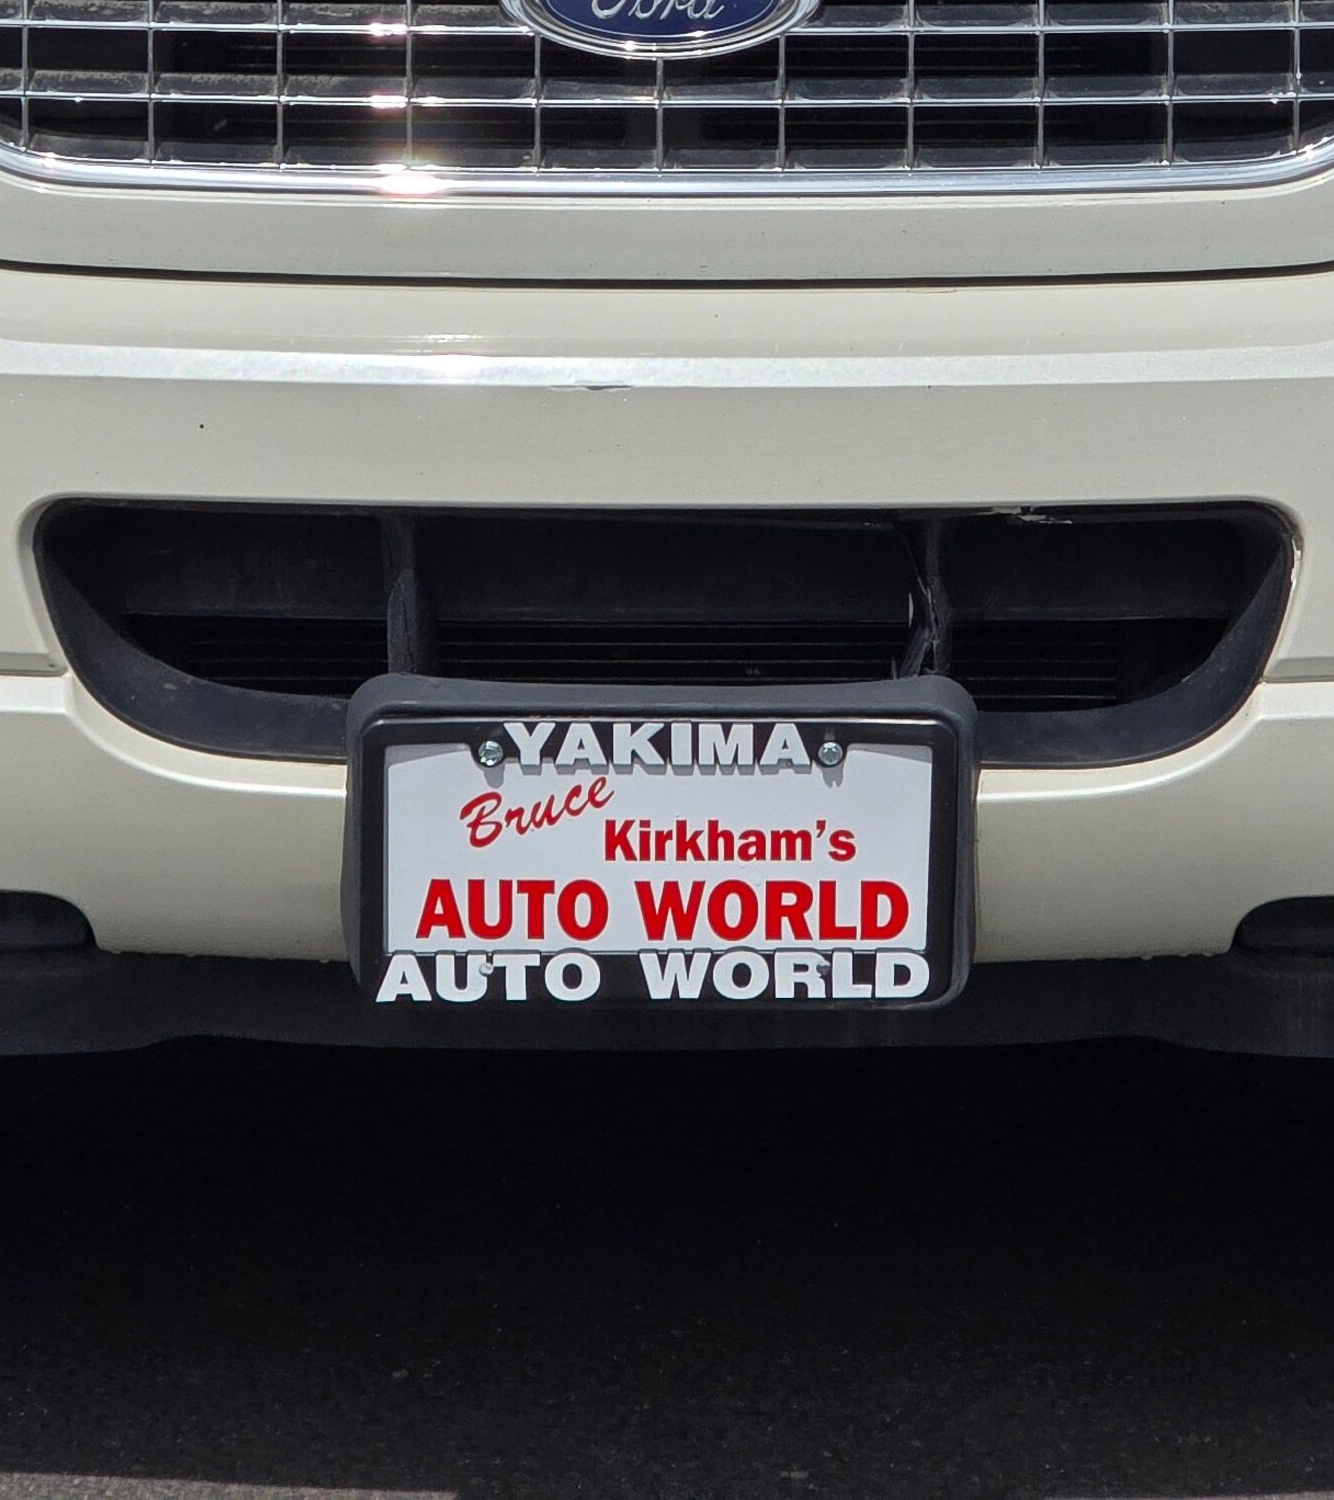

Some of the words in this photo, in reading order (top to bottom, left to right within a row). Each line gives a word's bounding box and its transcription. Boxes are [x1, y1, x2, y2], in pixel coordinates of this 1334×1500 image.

[503, 721, 811, 769] YAKIMA
[459, 775, 615, 848] Bruce
[604, 817, 857, 862] Kirkham's
[416, 878, 609, 941] AUTO
[635, 878, 910, 941] WORLD
[375, 951, 602, 1003] AUTO
[640, 951, 931, 1001] WORLD
